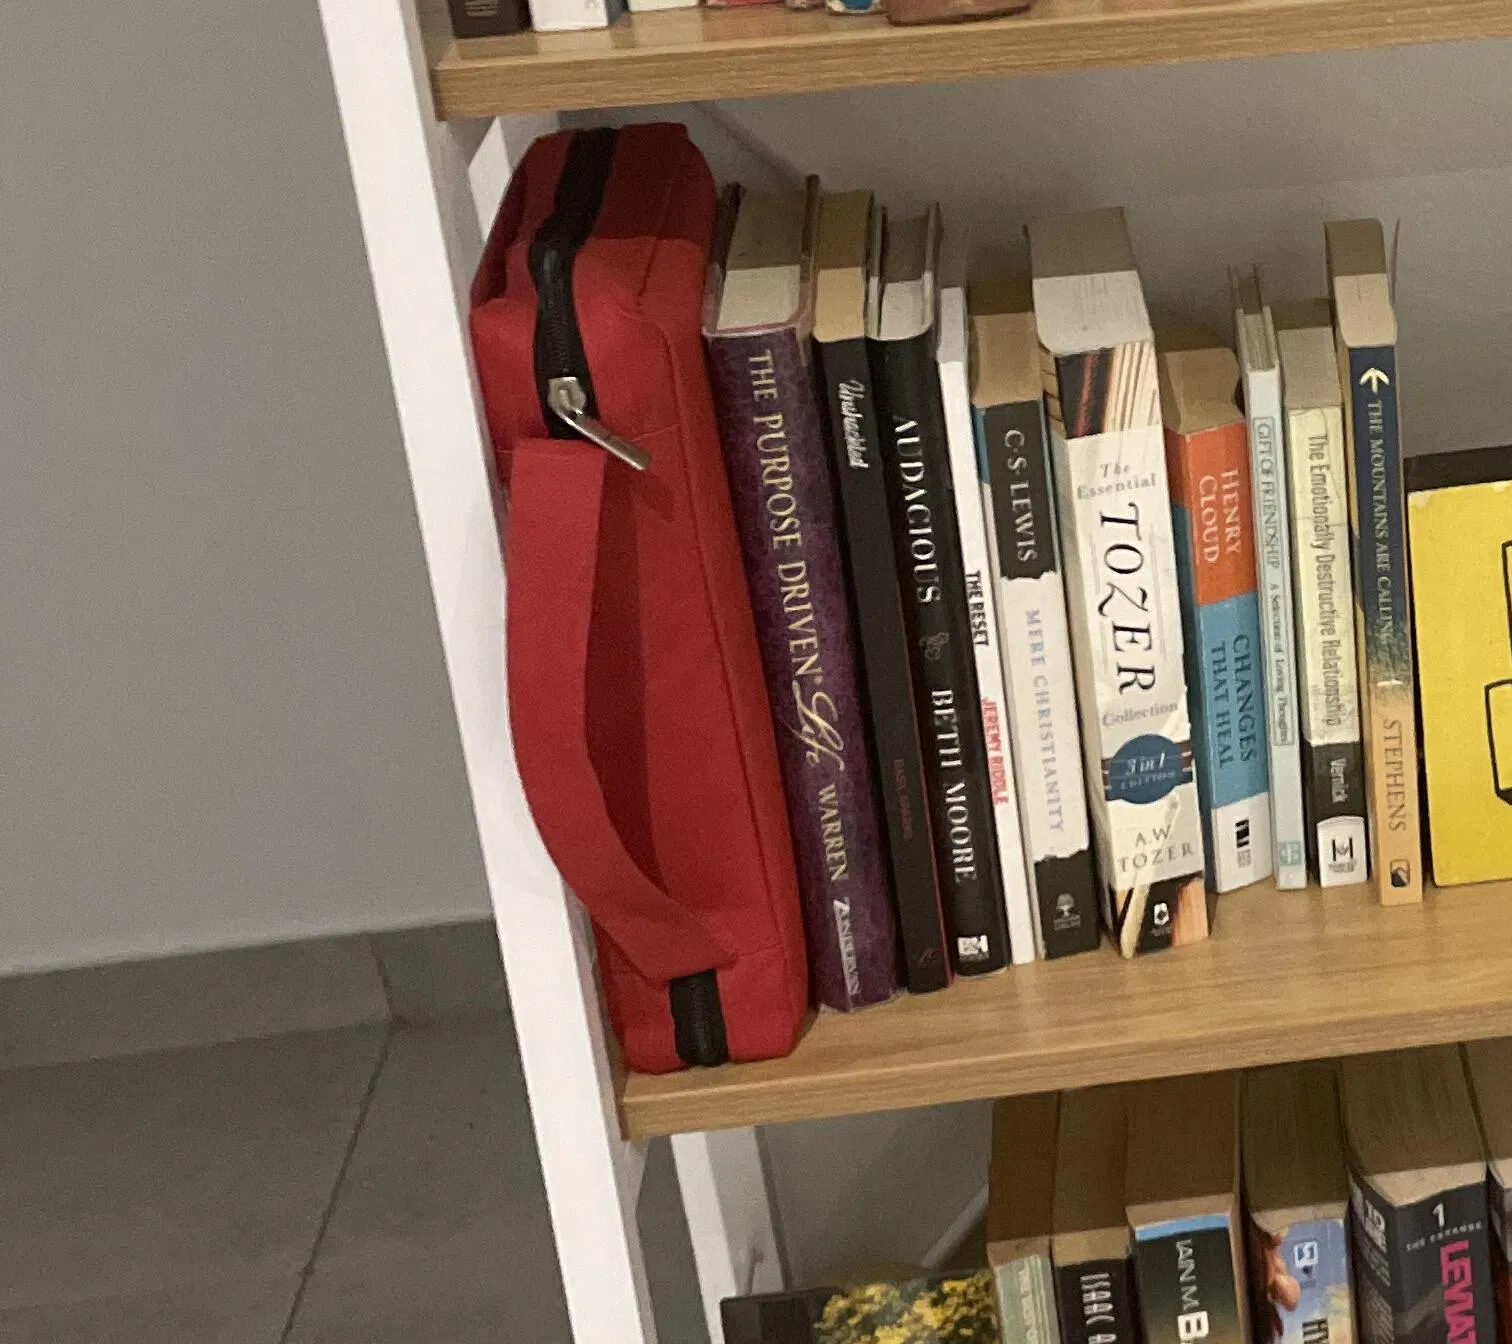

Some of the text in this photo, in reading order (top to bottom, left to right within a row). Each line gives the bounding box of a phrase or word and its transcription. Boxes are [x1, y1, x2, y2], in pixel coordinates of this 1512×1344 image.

[746, 350, 777, 402] THE
[752, 411, 802, 551] PURPOSE
[891, 413, 943, 604] AUDACIOUS
[1077, 473, 1157, 500] Essential
[1099, 462, 1131, 478] The
[1220, 469, 1243, 555] HENRY
[1256, 422, 1281, 569] GIFT OF FRIENDSHIP
[1008, 479, 1038, 562] LEWIS
[1195, 474, 1225, 564] CLOUD
[1367, 399, 1394, 644] THE MOUNTAINS ARE CALLING
[964, 570, 990, 647] THE RESET
[1097, 502, 1157, 695] TOZER
[1269, 582, 1279, 591] A
[1304, 433, 1343, 726] The Emotionally Destructive Relationship
[1103, 701, 1179, 727] Collection
[1208, 640, 1235, 770] THAT HEAL
[1230, 633, 1258, 761] CHANGES
[1273, 658, 1287, 692] Loving
[787, 676, 847, 774] Life
[979, 697, 1009, 805] JEREMY RIDDLE
[1025, 608, 1064, 834] MERE CHRISTIANITY
[930, 687, 979, 884] BETH MOORE
[1329, 757, 1349, 803] Vernick
[1382, 718, 1406, 832] STEPHENS
[815, 782, 849, 883] WARREN
[1117, 842, 1195, 873] TOZER
[1433, 1202, 1445, 1227] 1
[1079, 1272, 1115, 1325] ISAAC
[1173, 1238, 1197, 1282] IAN
